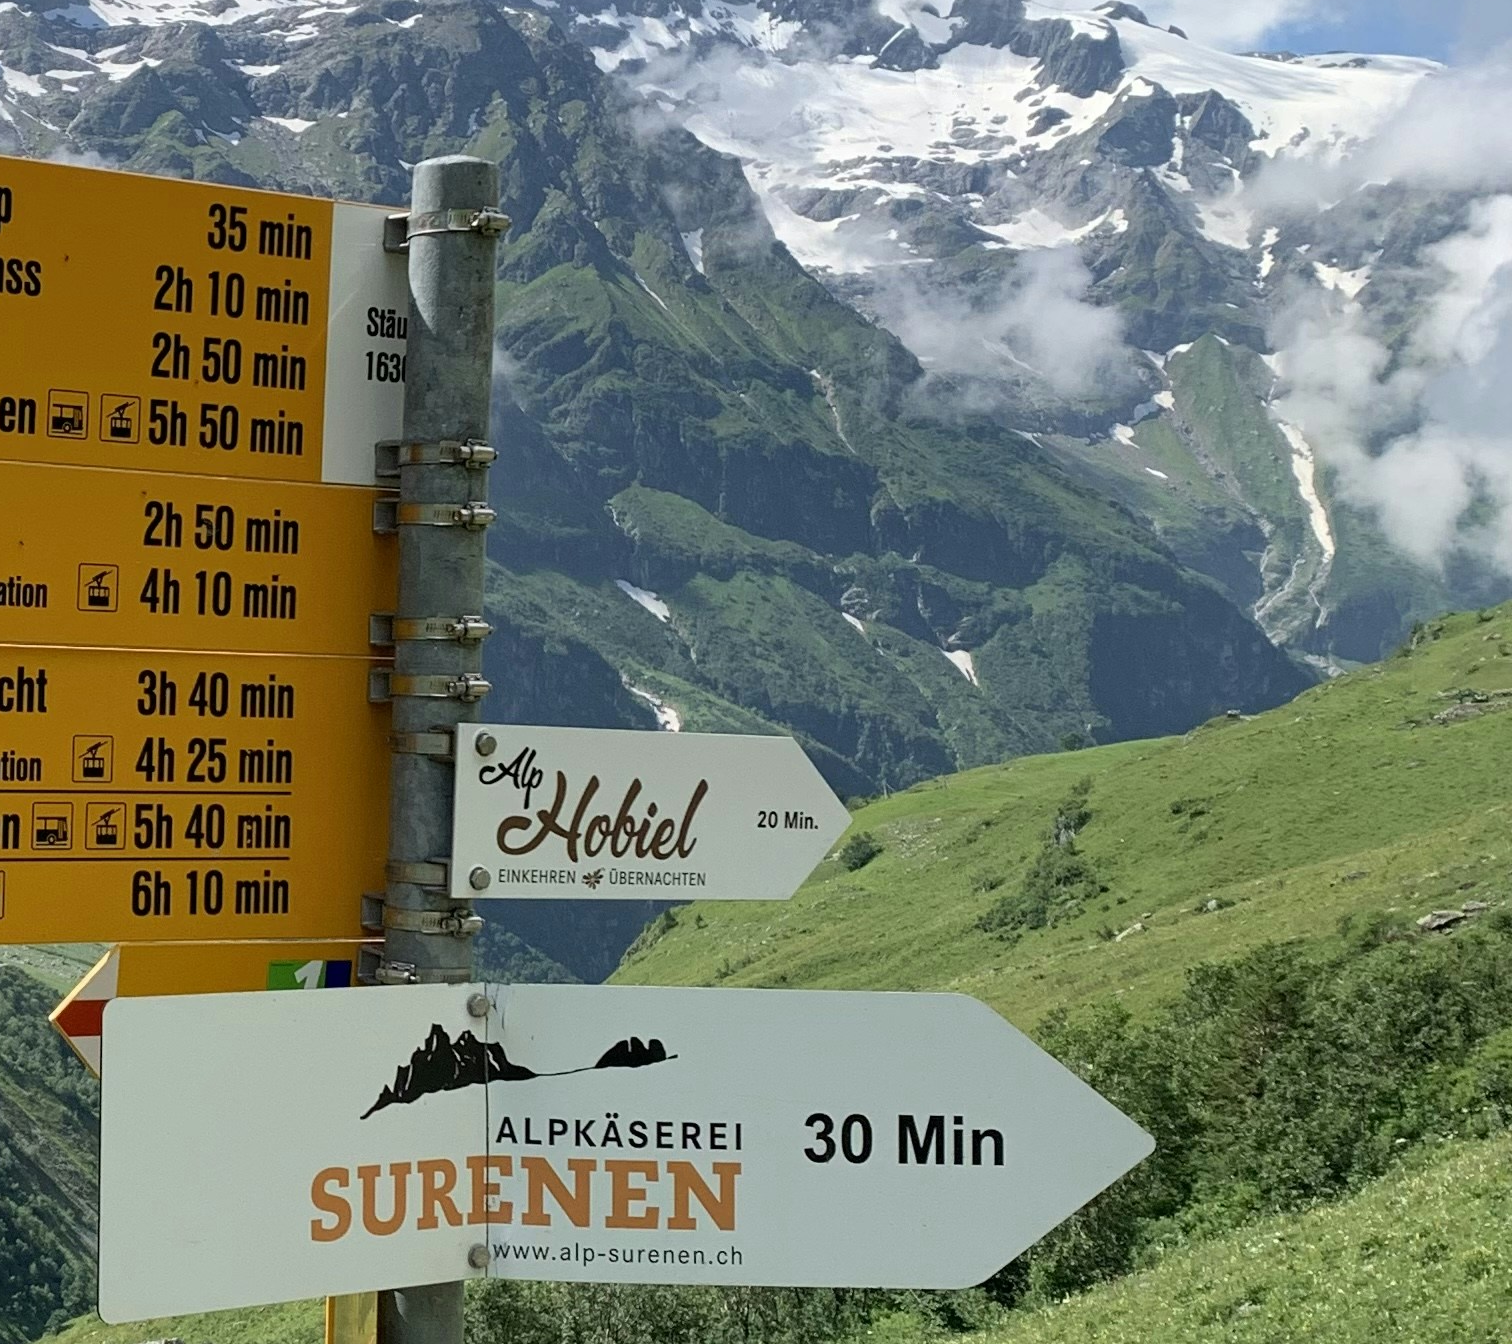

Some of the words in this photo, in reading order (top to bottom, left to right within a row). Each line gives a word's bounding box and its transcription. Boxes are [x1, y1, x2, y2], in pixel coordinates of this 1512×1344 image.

[207, 202, 247, 252] 35
[258, 213, 312, 260] min
[153, 264, 192, 313] 2h
[207, 270, 245, 319] 10
[255, 280, 310, 326] min
[367, 307, 408, 340] Stäu
[151, 331, 190, 380] 2h
[201, 336, 242, 386] 50
[251, 344, 307, 391] min
[148, 399, 187, 448] 5h
[198, 403, 239, 451] 50
[249, 410, 304, 456] min
[143, 500, 182, 548] 2h
[194, 503, 235, 551] 50
[245, 509, 299, 555] min
[139, 568, 180, 615] 4h
[194, 570, 231, 617] 10
[243, 573, 297, 620] min
[136, 669, 177, 716] 3h
[188, 671, 229, 718] 40
[240, 674, 294, 719] min
[135, 737, 175, 784] 4h
[187, 738, 227, 784] 25
[238, 740, 292, 784] min
[479, 747, 543, 809] Alp
[133, 804, 173, 850] 5h
[184, 804, 225, 850] 40
[237, 805, 291, 849] min
[497, 770, 708, 862] Hobiel
[757, 811, 778, 828] 20
[785, 812, 819, 830] Min.
[131, 870, 171, 916] 6h
[187, 870, 224, 915] 10
[235, 869, 289, 915] min
[499, 869, 575, 884] EINKEHREN
[609, 870, 706, 886] ÜBERNACHTEN
[496, 1113, 742, 1151] ALPKÄSEREI
[804, 1113, 872, 1164] 30
[898, 1114, 1005, 1167] Min
[310, 1155, 742, 1243] SURENEN
[492, 1241, 742, 1266] www.alp-surenen.ch
